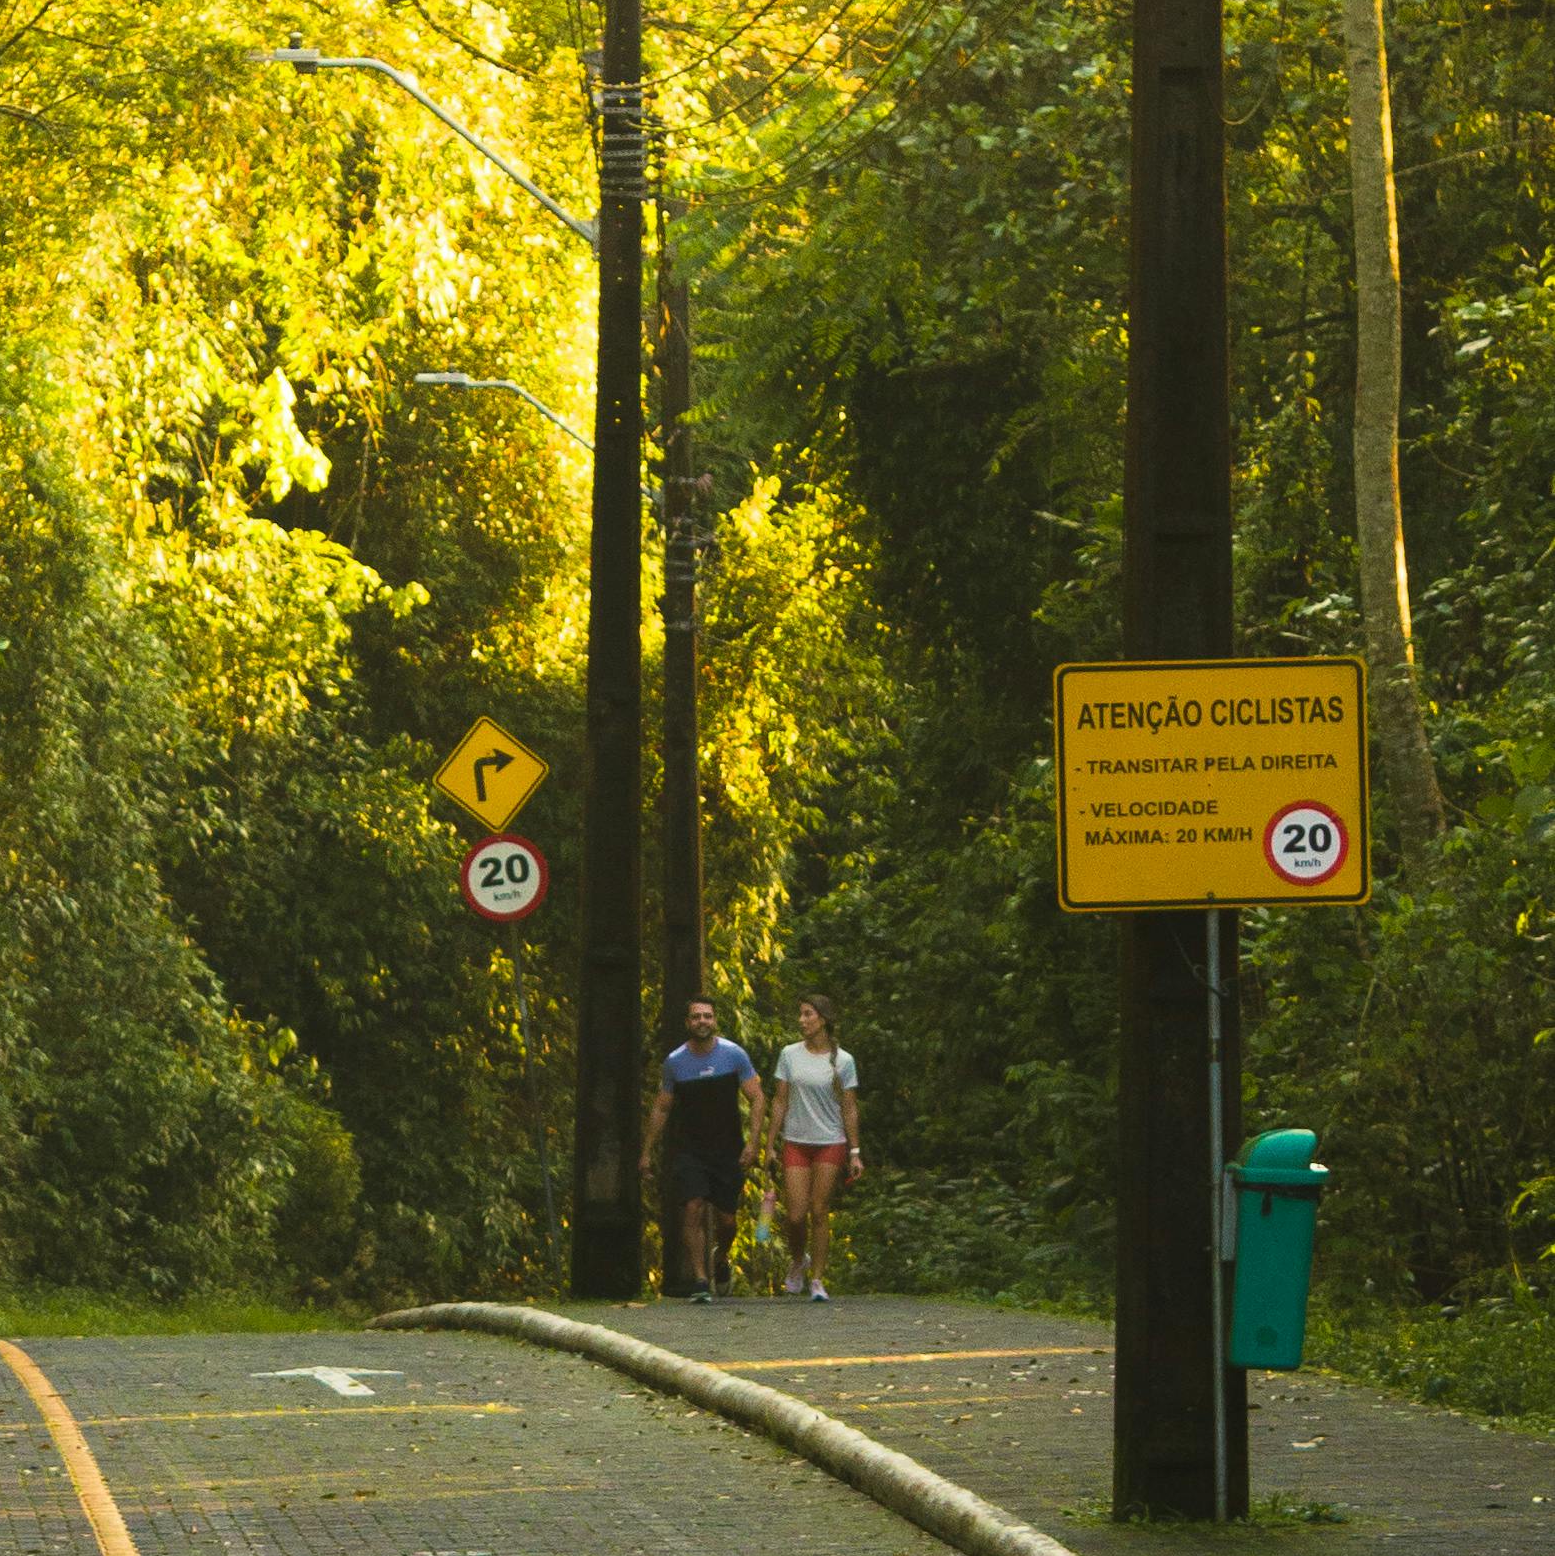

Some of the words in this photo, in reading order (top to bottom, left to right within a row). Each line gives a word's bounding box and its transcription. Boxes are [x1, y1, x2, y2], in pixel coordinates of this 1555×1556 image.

[1077, 695, 1202, 734] ATENÇÃO
[1210, 695, 1344, 727] CICLISTAS
[1087, 757, 1198, 775] TRANSITAR
[1203, 755, 1255, 772] PELA
[1260, 754, 1338, 771] DIREITA
[1090, 800, 1219, 818] VELOCIDADE
[1085, 827, 1169, 845] MÁXIMA:
[1176, 828, 1197, 844] 20
[1204, 826, 1253, 843] KM/H
[1282, 823, 1332, 854] 20
[479, 853, 530, 888] 20
[1294, 857, 1322, 869] km/h
